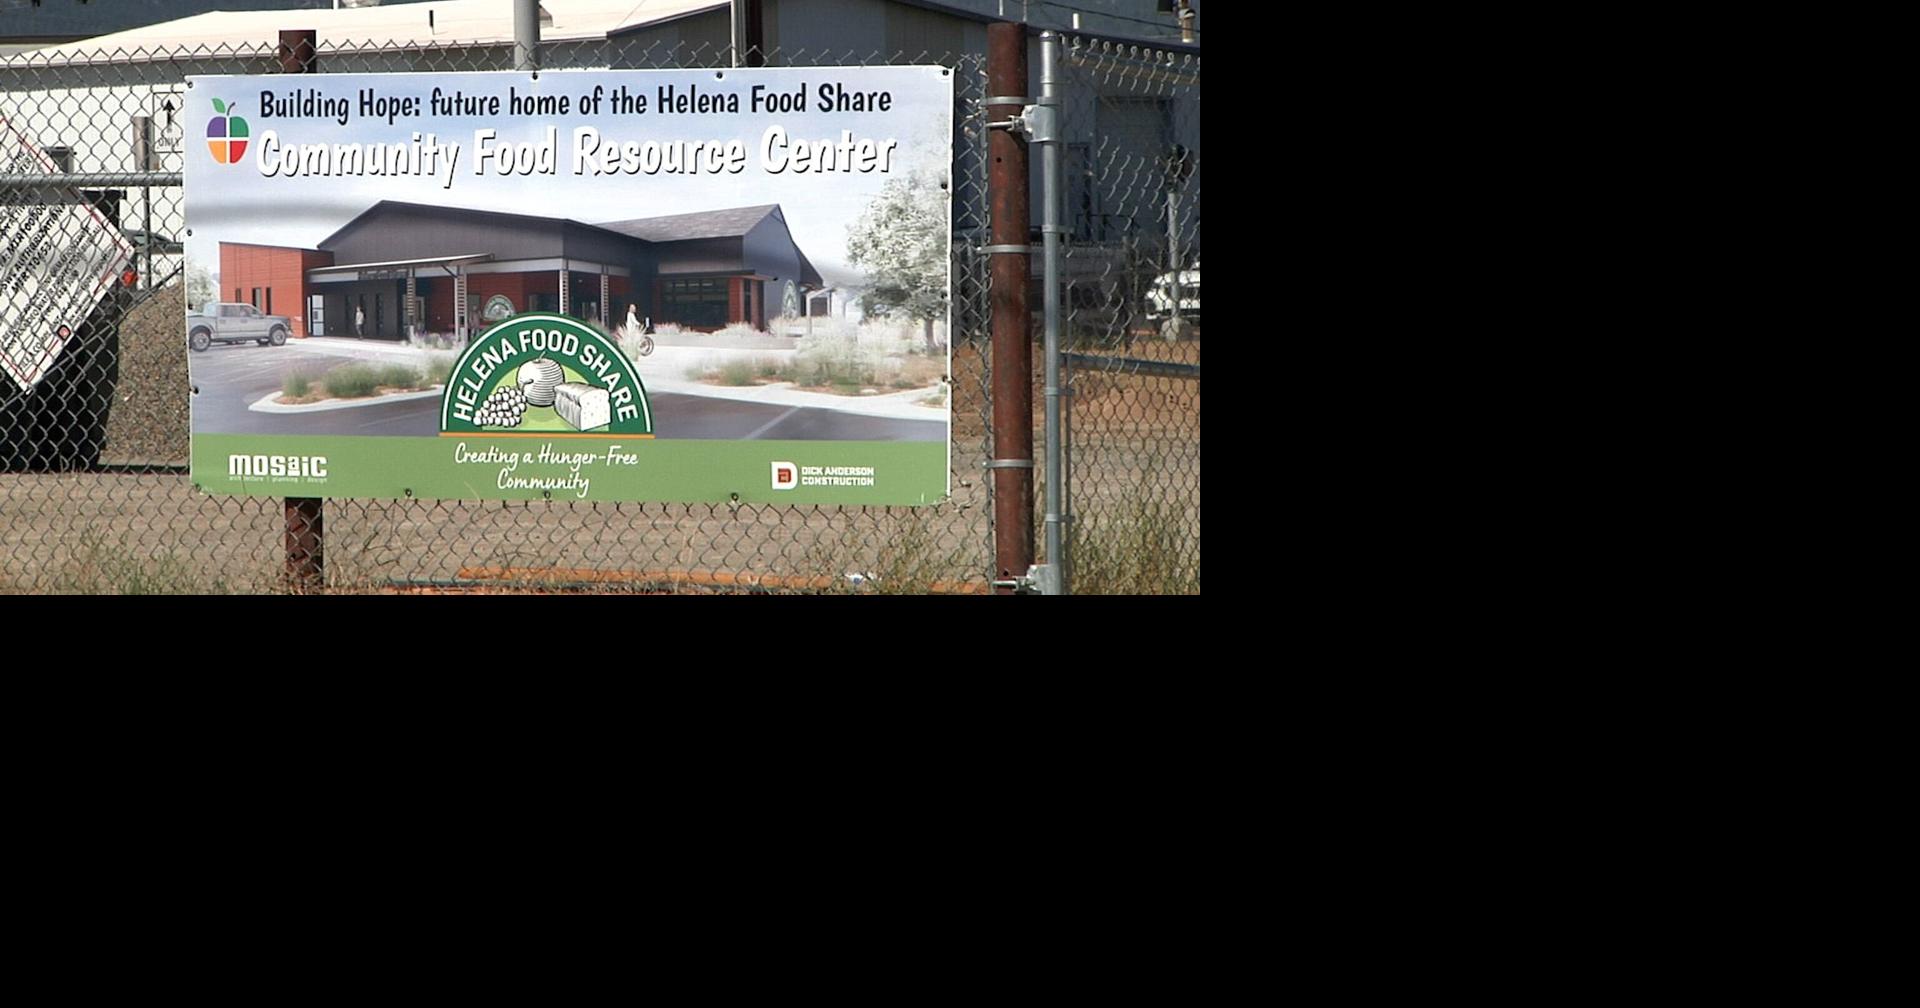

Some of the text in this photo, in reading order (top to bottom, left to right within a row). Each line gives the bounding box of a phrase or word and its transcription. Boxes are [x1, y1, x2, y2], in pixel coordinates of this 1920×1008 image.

[260, 82, 892, 125] Building Hope: future home of the Helena Food Share
[256, 124, 897, 189] Community Food Resource Center
[453, 329, 639, 422] HELENA FOOD SHARE
[455, 442, 639, 471] Creating a Hunger-Free
[801, 467, 874, 476] DICK ANDERSON
[497, 468, 590, 498] Community
[802, 476, 874, 486] CONSTRUCTION
